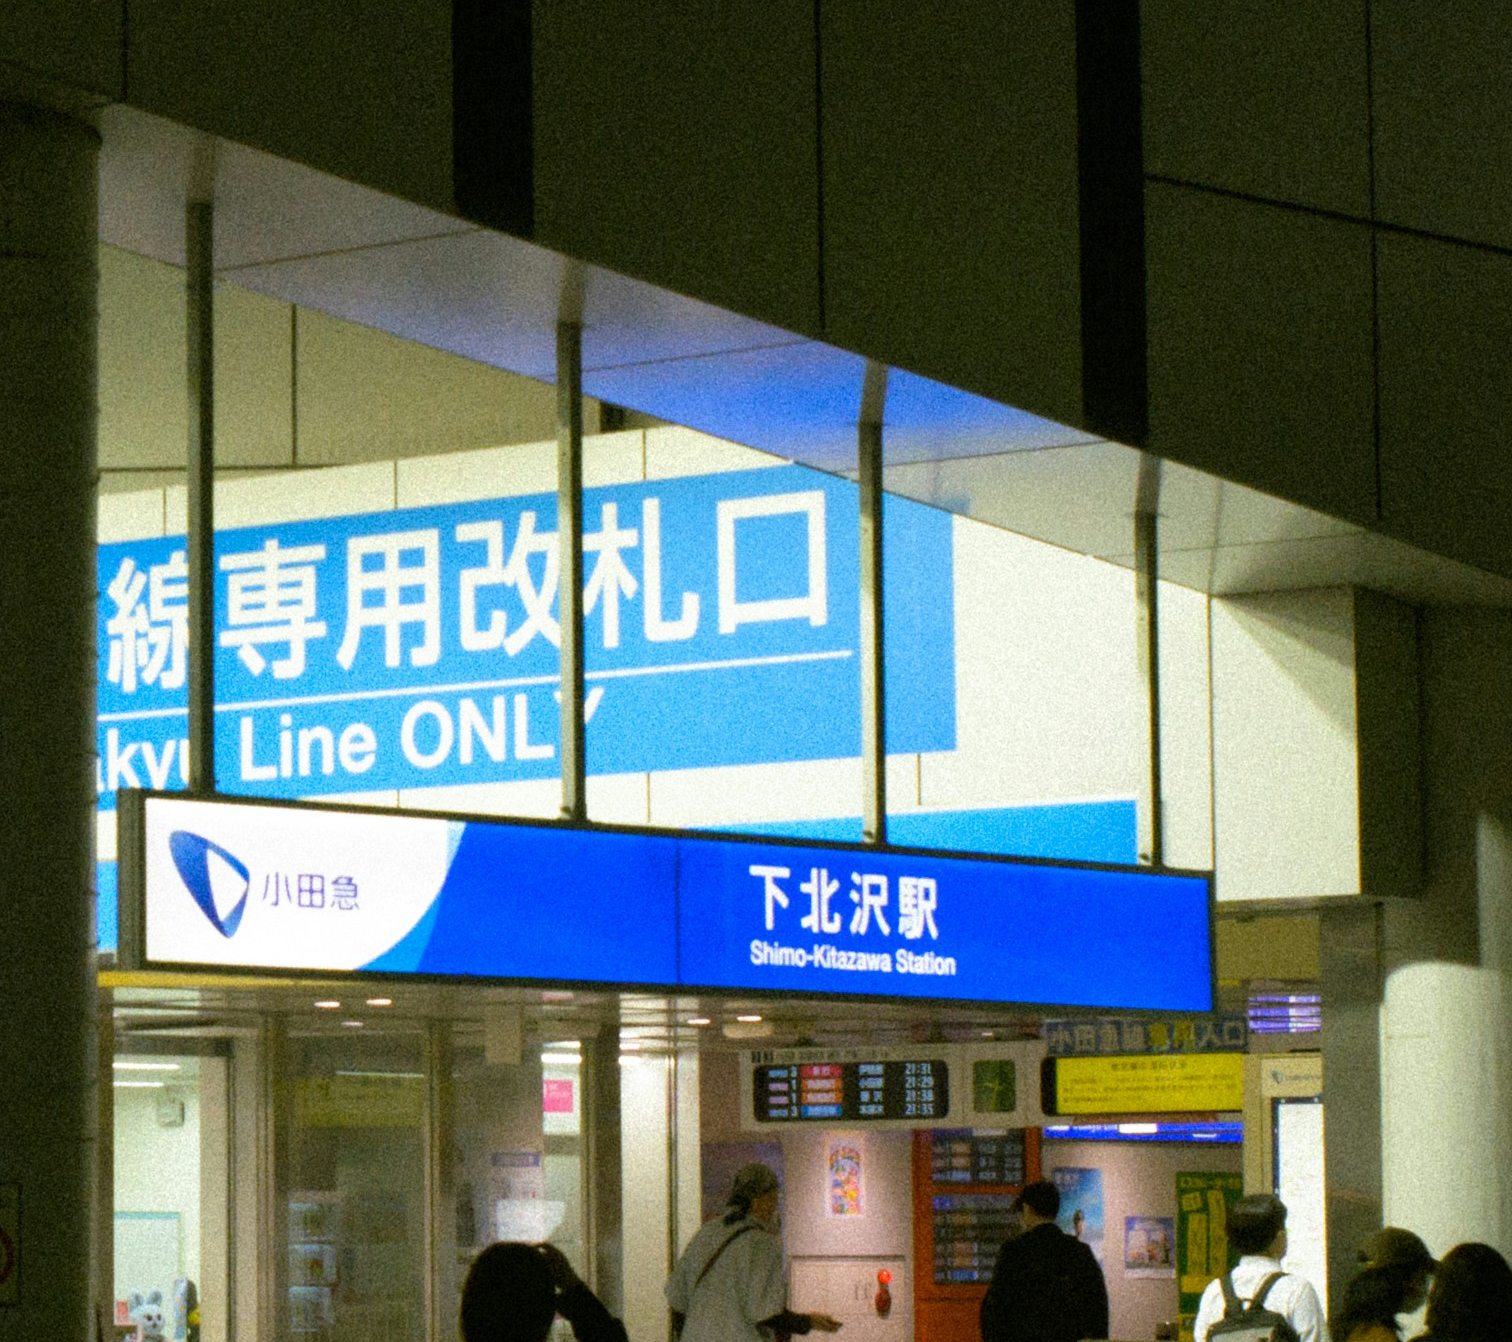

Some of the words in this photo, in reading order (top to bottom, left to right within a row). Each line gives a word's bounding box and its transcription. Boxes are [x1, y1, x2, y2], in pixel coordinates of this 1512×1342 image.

[239, 713, 377, 782] Line
[401, 687, 604, 769] ONLY
[263, 873, 360, 912] 小田急
[749, 862, 939, 943] 下北沢駅
[749, 939, 892, 975] Shimo-Kitazawa
[894, 948, 957, 977] Station
